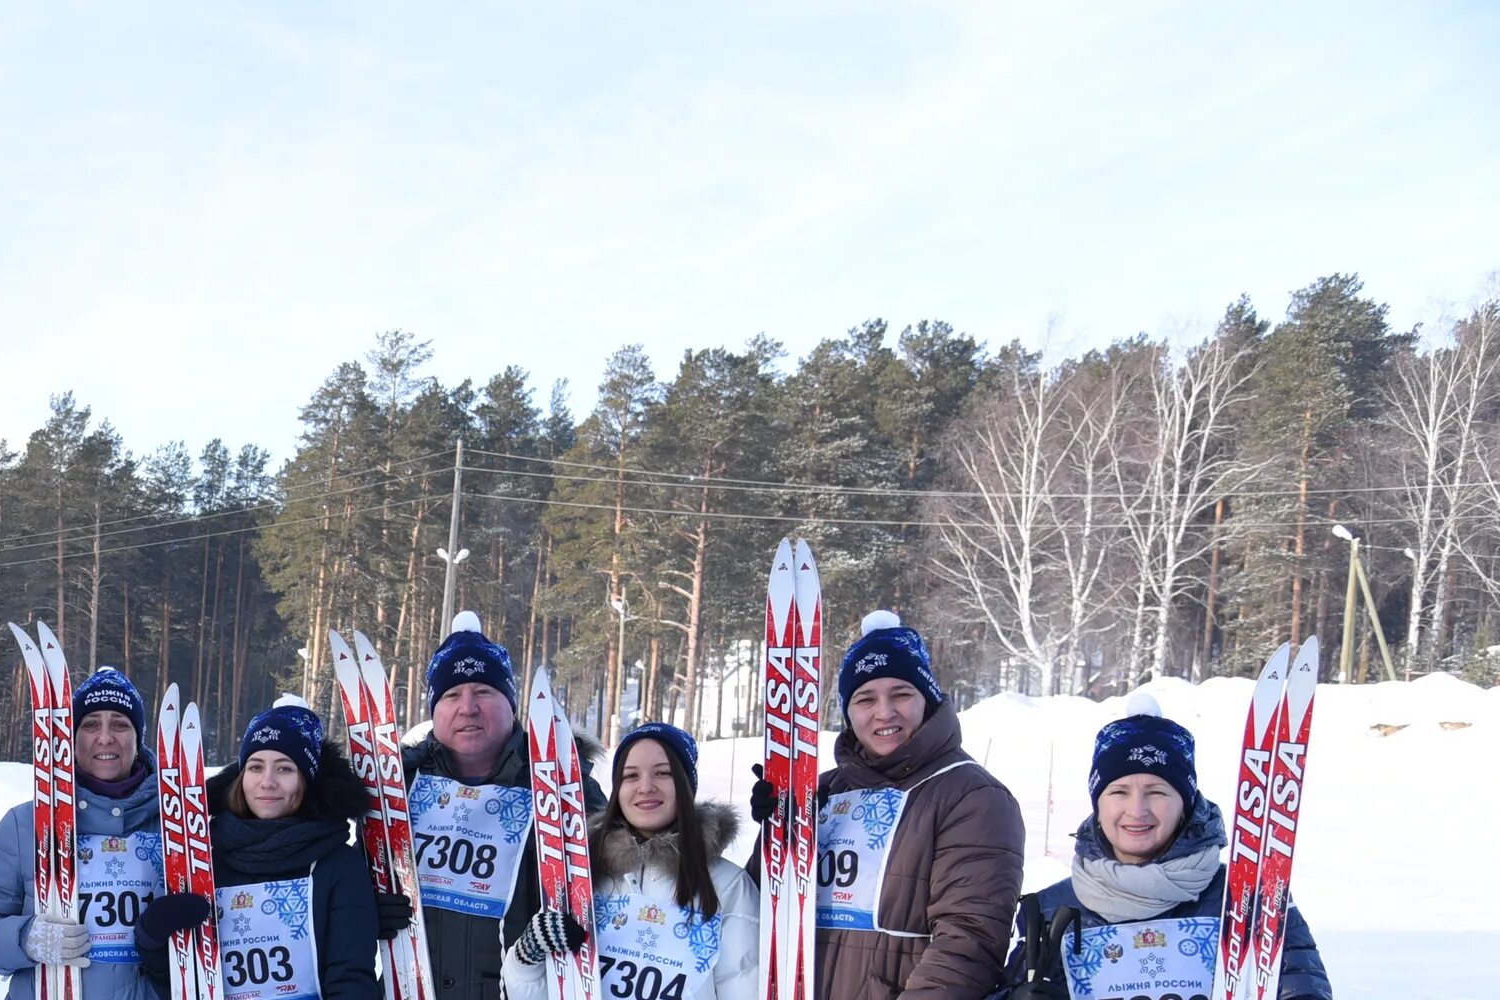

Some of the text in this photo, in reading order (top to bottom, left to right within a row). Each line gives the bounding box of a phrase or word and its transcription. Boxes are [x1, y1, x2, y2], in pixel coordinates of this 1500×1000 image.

[84, 696, 132, 710] РОССИИ
[86, 690, 130, 702] ЛЫЖНЯ
[766, 646, 791, 760] TISA
[793, 646, 819, 760] TISA
[35, 707, 51, 807] TISA
[53, 707, 71, 808] TISA
[374, 722, 407, 827] TISA
[162, 767, 184, 856] TISA
[184, 785, 209, 875] TISA
[534, 761, 560, 864] TISA
[560, 781, 588, 883] TISA
[1232, 748, 1270, 865] TISA
[1265, 740, 1305, 858] TISA
[415, 832, 497, 879] 7308
[456, 827, 493, 840] РОССИИ
[768, 812, 784, 899] sport
[795, 806, 810, 898] sport
[80, 880, 152, 889] ЛЫЖНЯ РОССИИ
[469, 881, 491, 891] RAY
[817, 850, 858, 887] 09
[833, 892, 853, 900] RAY
[454, 898, 489, 910] ОБЛАСТЬ
[821, 913, 854, 922] ОБЛАСТЬ
[88, 950, 128, 958] ДЛОВСКАЯ
[220, 935, 280, 947] ЖНЯ РОССИИ
[222, 946, 294, 987] 303
[605, 945, 683, 968] ЛЫЖНЯ РОССИИ
[1225, 901, 1243, 997] sport
[1257, 896, 1276, 992] sport
[1108, 979, 1202, 992] ЛЫЖНЯ РОССИИ
